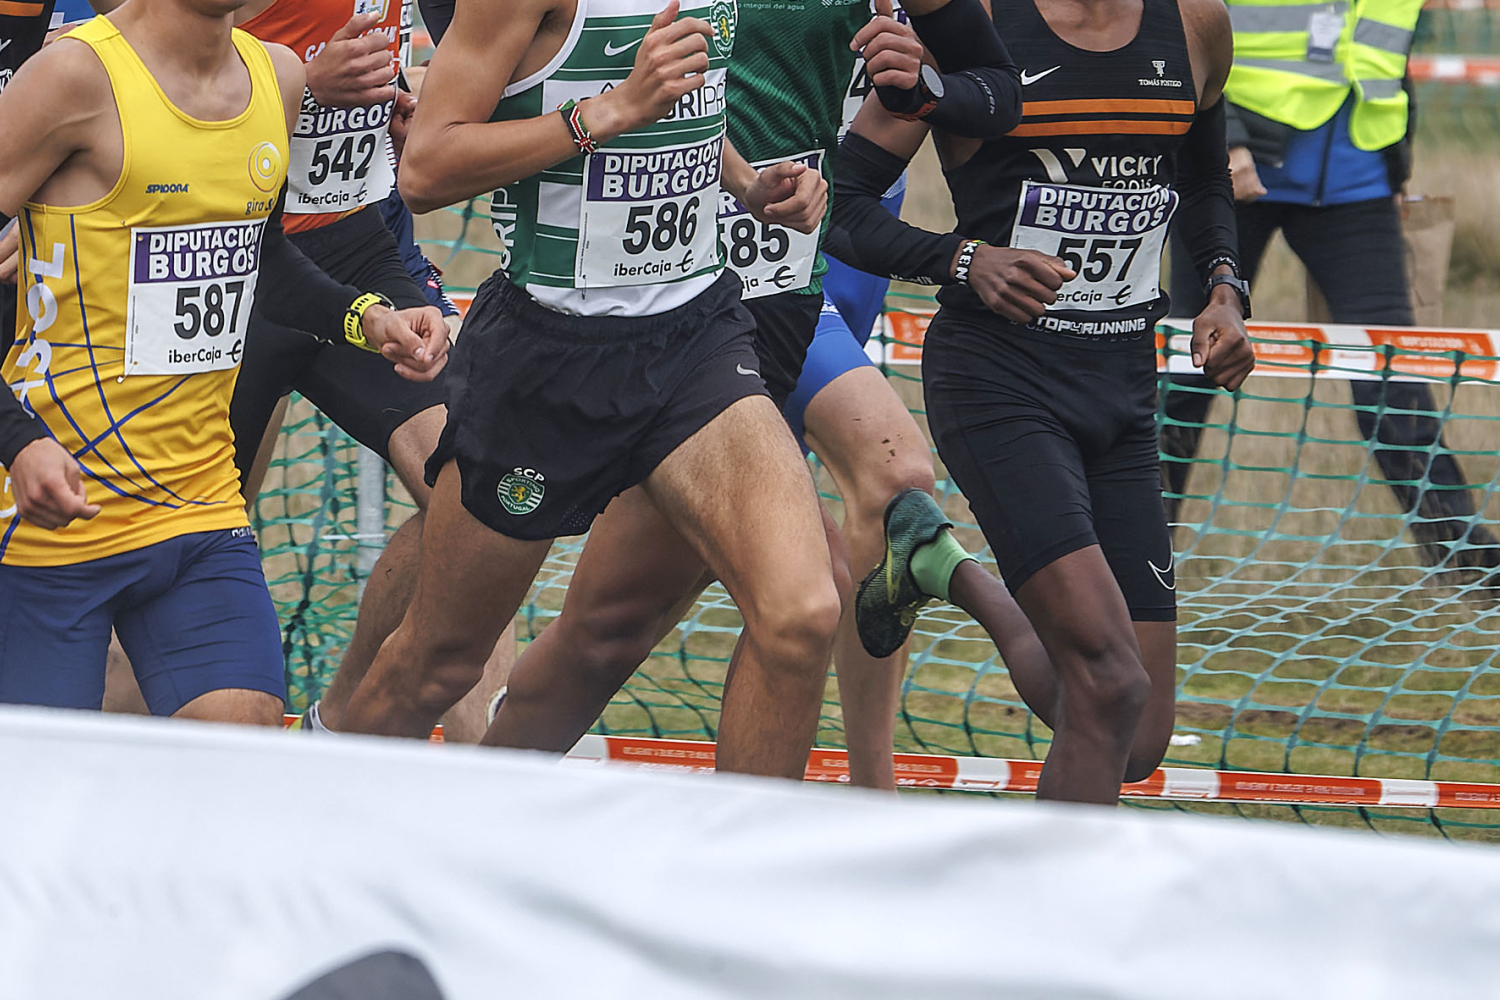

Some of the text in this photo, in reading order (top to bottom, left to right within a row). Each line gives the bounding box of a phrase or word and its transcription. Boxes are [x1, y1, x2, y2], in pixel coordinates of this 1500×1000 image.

[296, 100, 394, 134] BURGOS
[308, 133, 377, 186] 542
[604, 138, 721, 174] DIPUTACIÓN
[1091, 154, 1163, 177] VICKY
[602, 158, 718, 199] BURGOS
[298, 192, 350, 206] iberCaja
[1039, 183, 1170, 212] DIPUTACIÓN
[622, 196, 700, 255] 586
[1034, 205, 1167, 234] BURGOS
[149, 222, 261, 254] DIPUTACIÓN
[148, 244, 256, 280] BURGOS
[613, 259, 672, 277] iberCaja
[955, 242, 978, 285] KEN
[1057, 237, 1144, 284] 557
[173, 280, 246, 340] 587
[1055, 290, 1103, 305] erCaja
[168, 345, 222, 365] iberCaja
[513, 466, 545, 482] SCP
